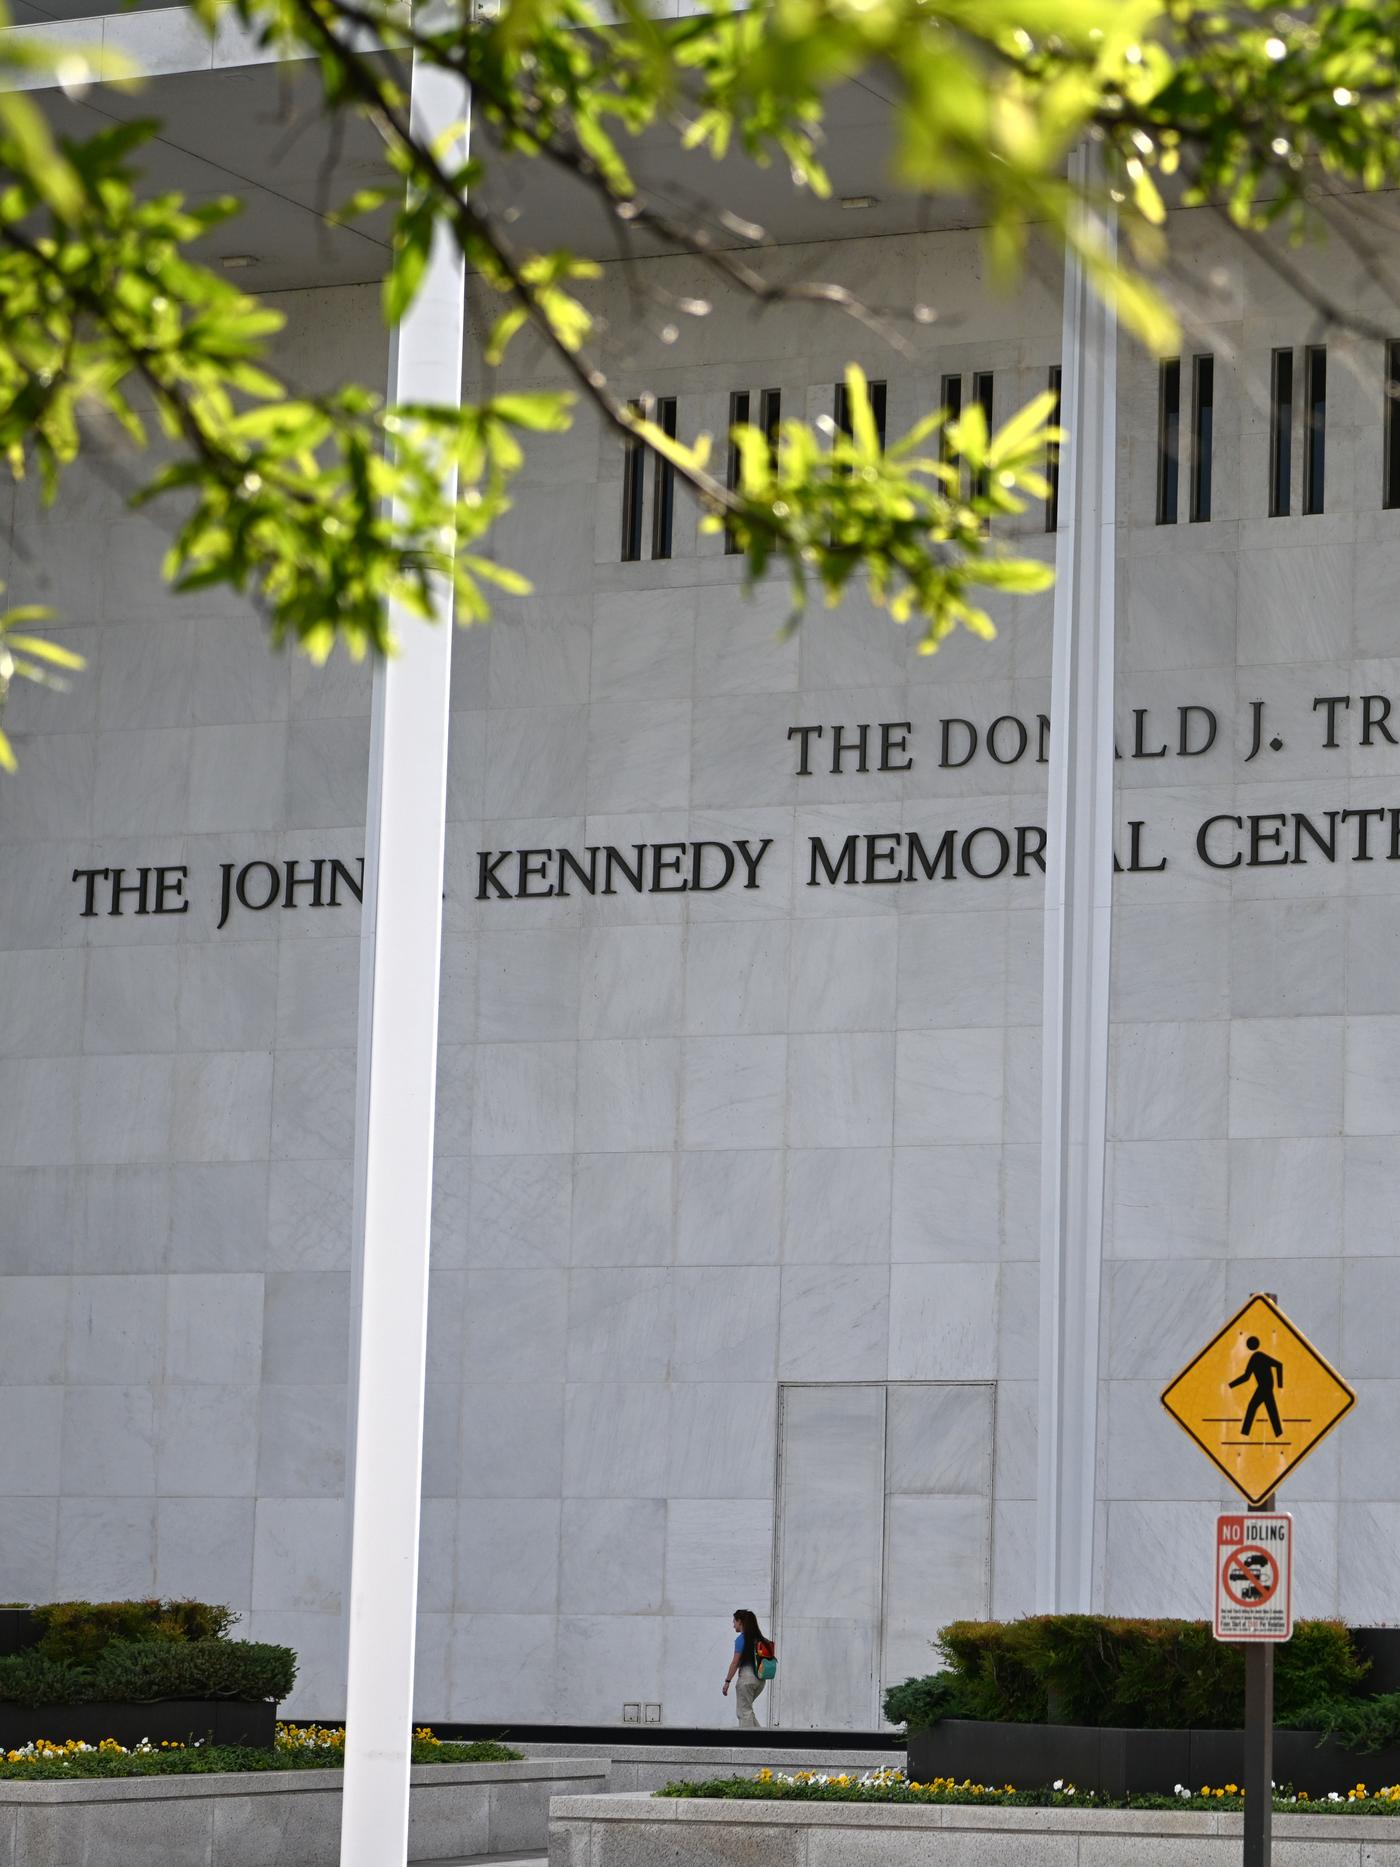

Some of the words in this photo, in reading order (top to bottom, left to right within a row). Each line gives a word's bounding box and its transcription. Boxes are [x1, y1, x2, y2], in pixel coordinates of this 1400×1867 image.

[787, 722, 913, 776] THE
[937, 705, 1218, 769] DOLD
[1243, 701, 1284, 763] J.
[72, 865, 189, 918] THE
[216, 857, 363, 930] JOHN
[475, 838, 774, 901] KENNEDY
[806, 820, 1168, 887] MEMORL
[1222, 1524, 1241, 1541] NO
[1246, 1524, 1285, 1542] IDLING
